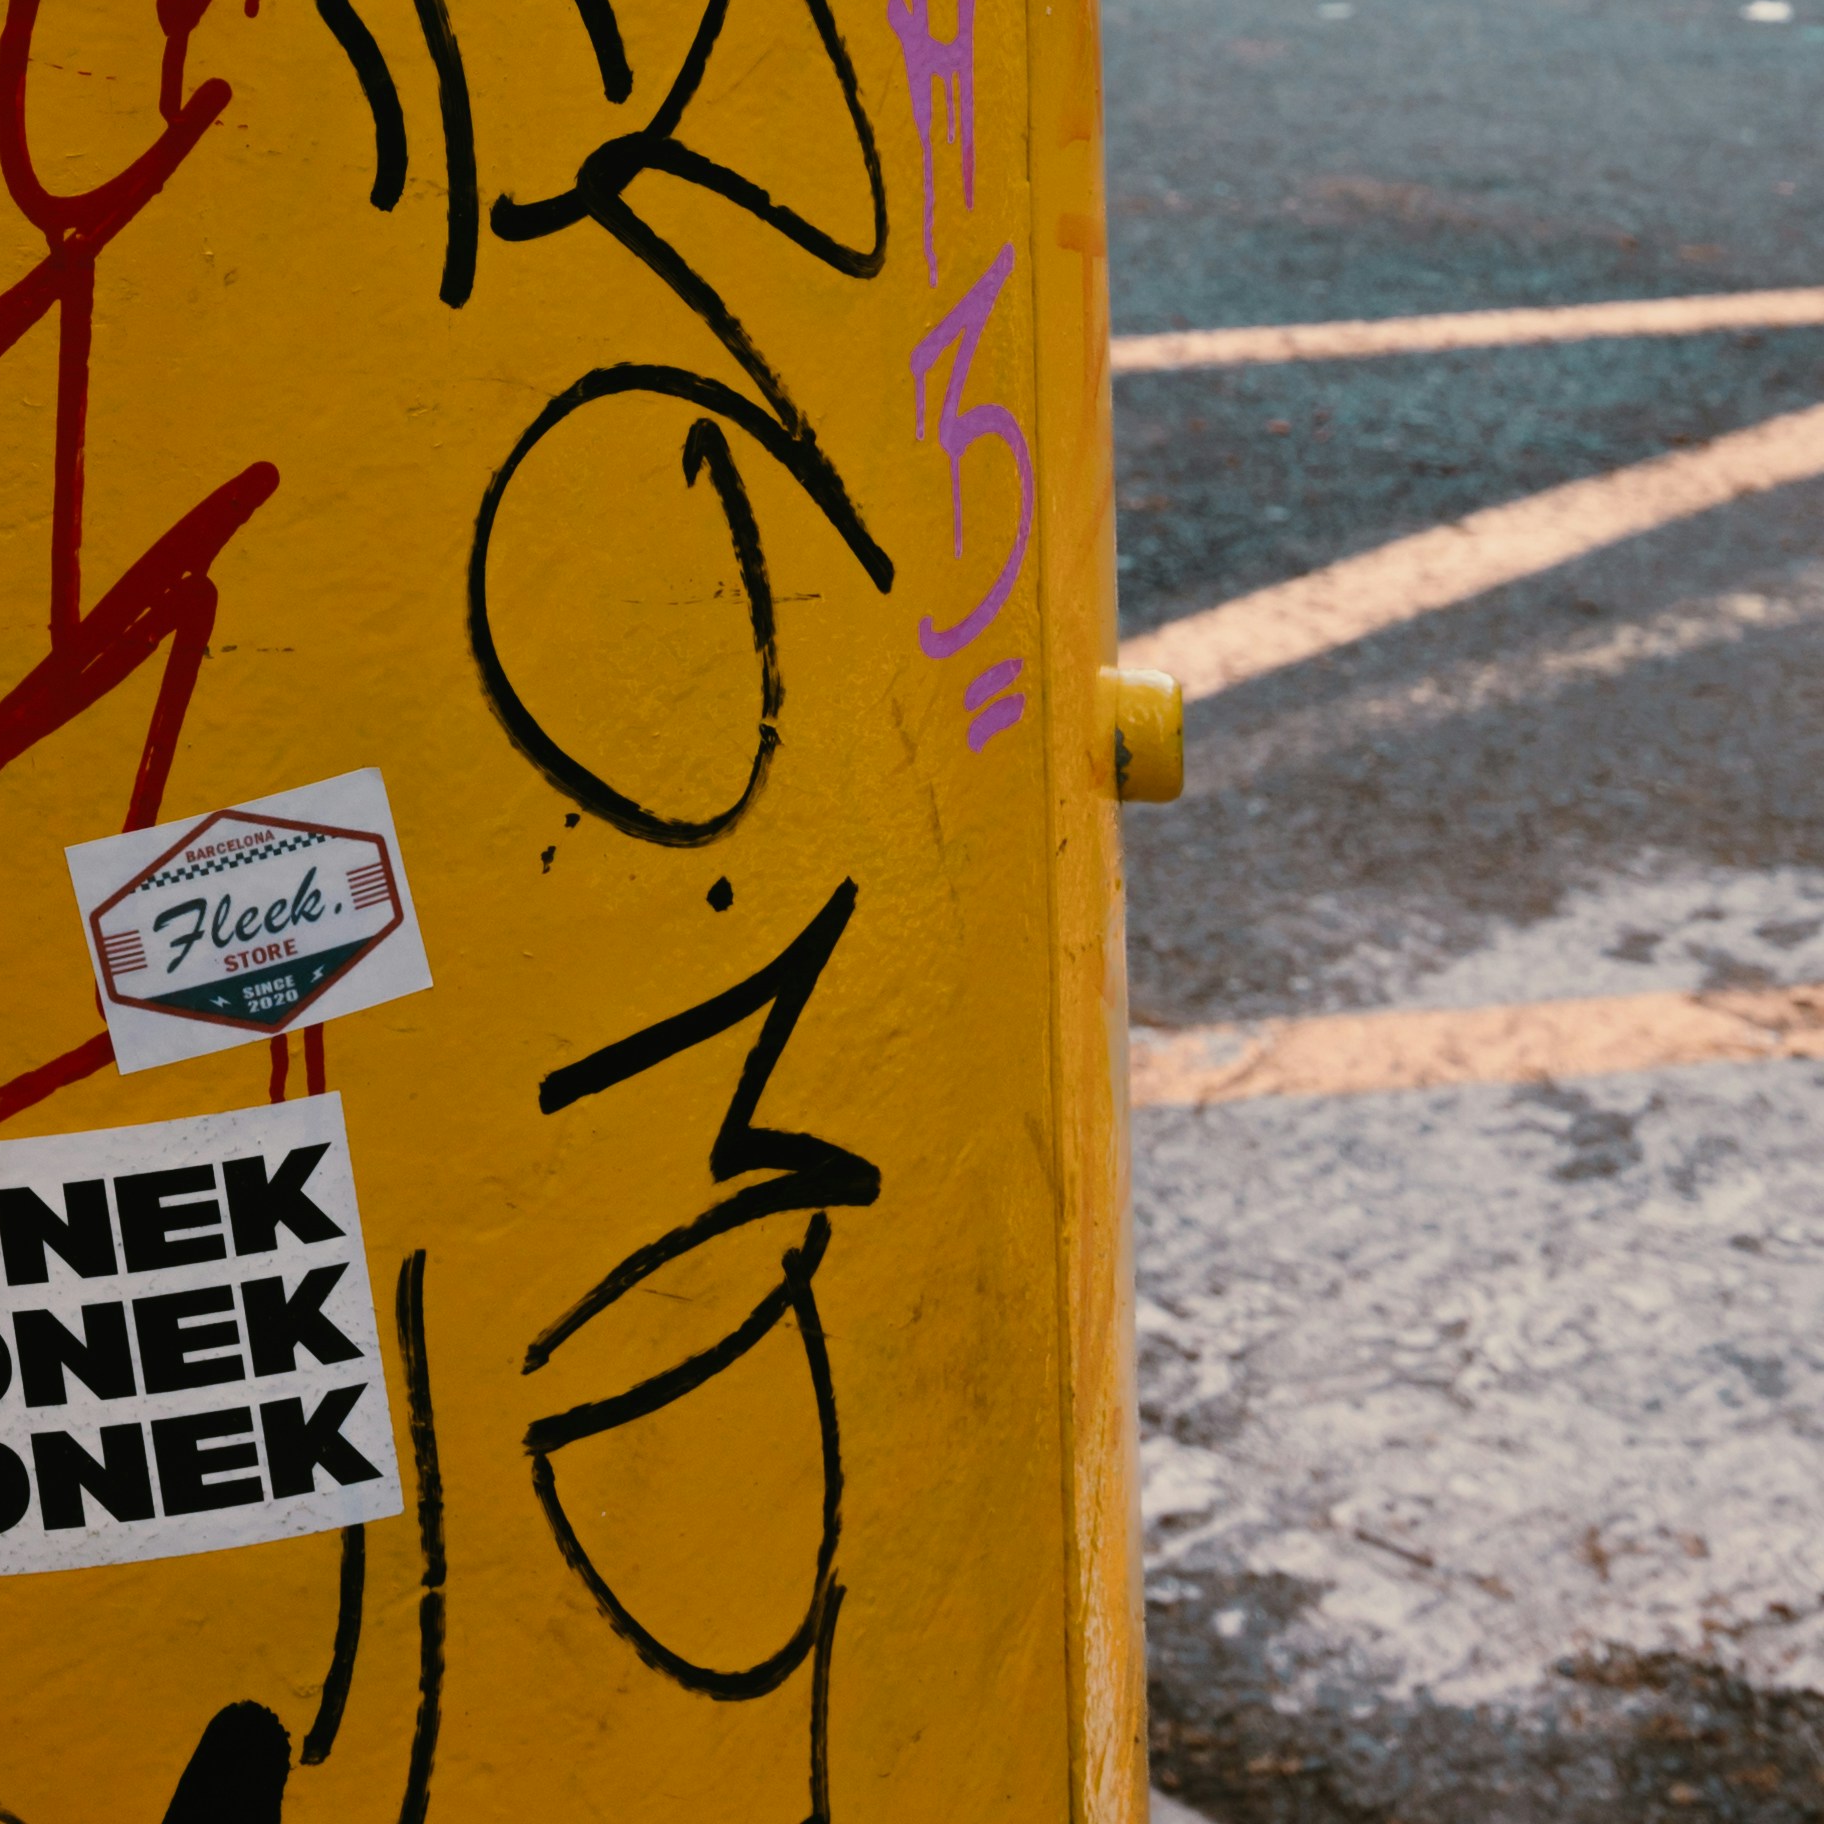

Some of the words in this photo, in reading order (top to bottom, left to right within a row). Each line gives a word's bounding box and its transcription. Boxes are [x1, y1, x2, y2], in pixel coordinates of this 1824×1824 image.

[185, 829, 275, 863] BARCELONA
[223, 937, 299, 972] STORE
[242, 974, 296, 1001] SINCE
[247, 989, 299, 1014] 2020
